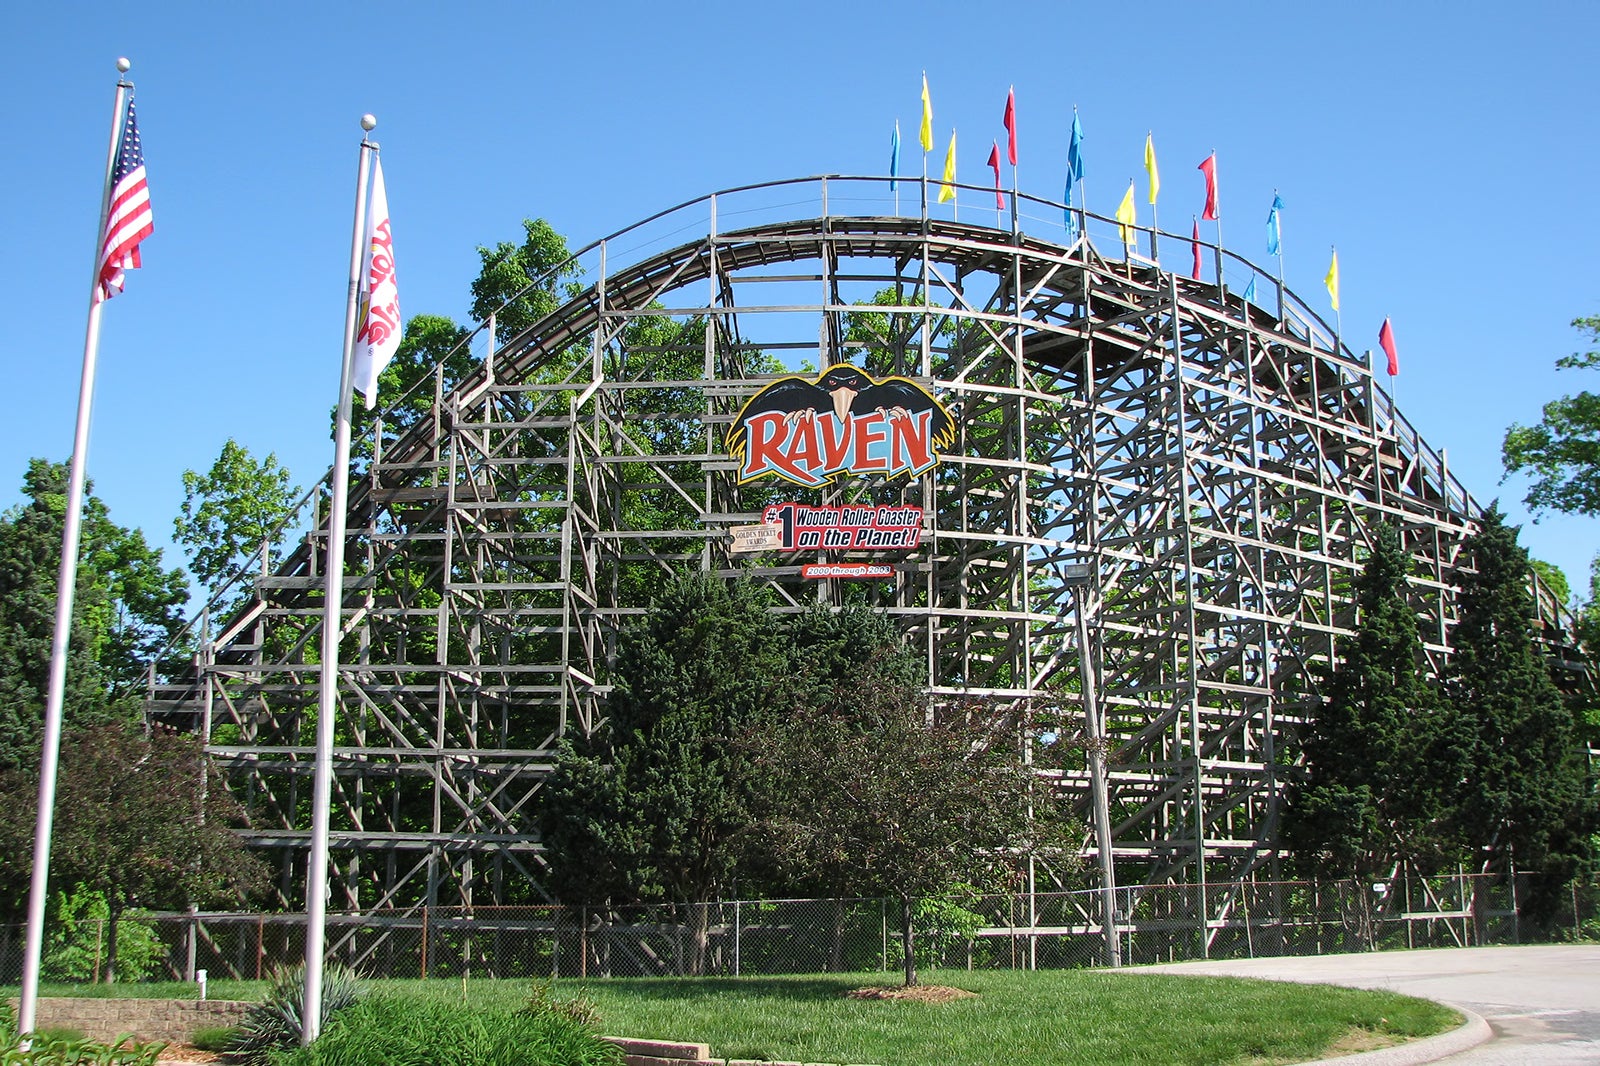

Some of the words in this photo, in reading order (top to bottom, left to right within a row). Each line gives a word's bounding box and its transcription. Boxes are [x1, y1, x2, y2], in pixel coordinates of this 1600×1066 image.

[745, 412, 932, 483] RAVEN
[796, 508, 839, 526] Wooden
[841, 508, 875, 526] Roller
[877, 508, 920, 526] Coaster
[735, 531, 757, 539] GOLDEN
[799, 531, 820, 546] on
[824, 528, 852, 546] the
[807, 567, 830, 575] 2000
[831, 567, 866, 576] through
[868, 566, 891, 574] 2003
